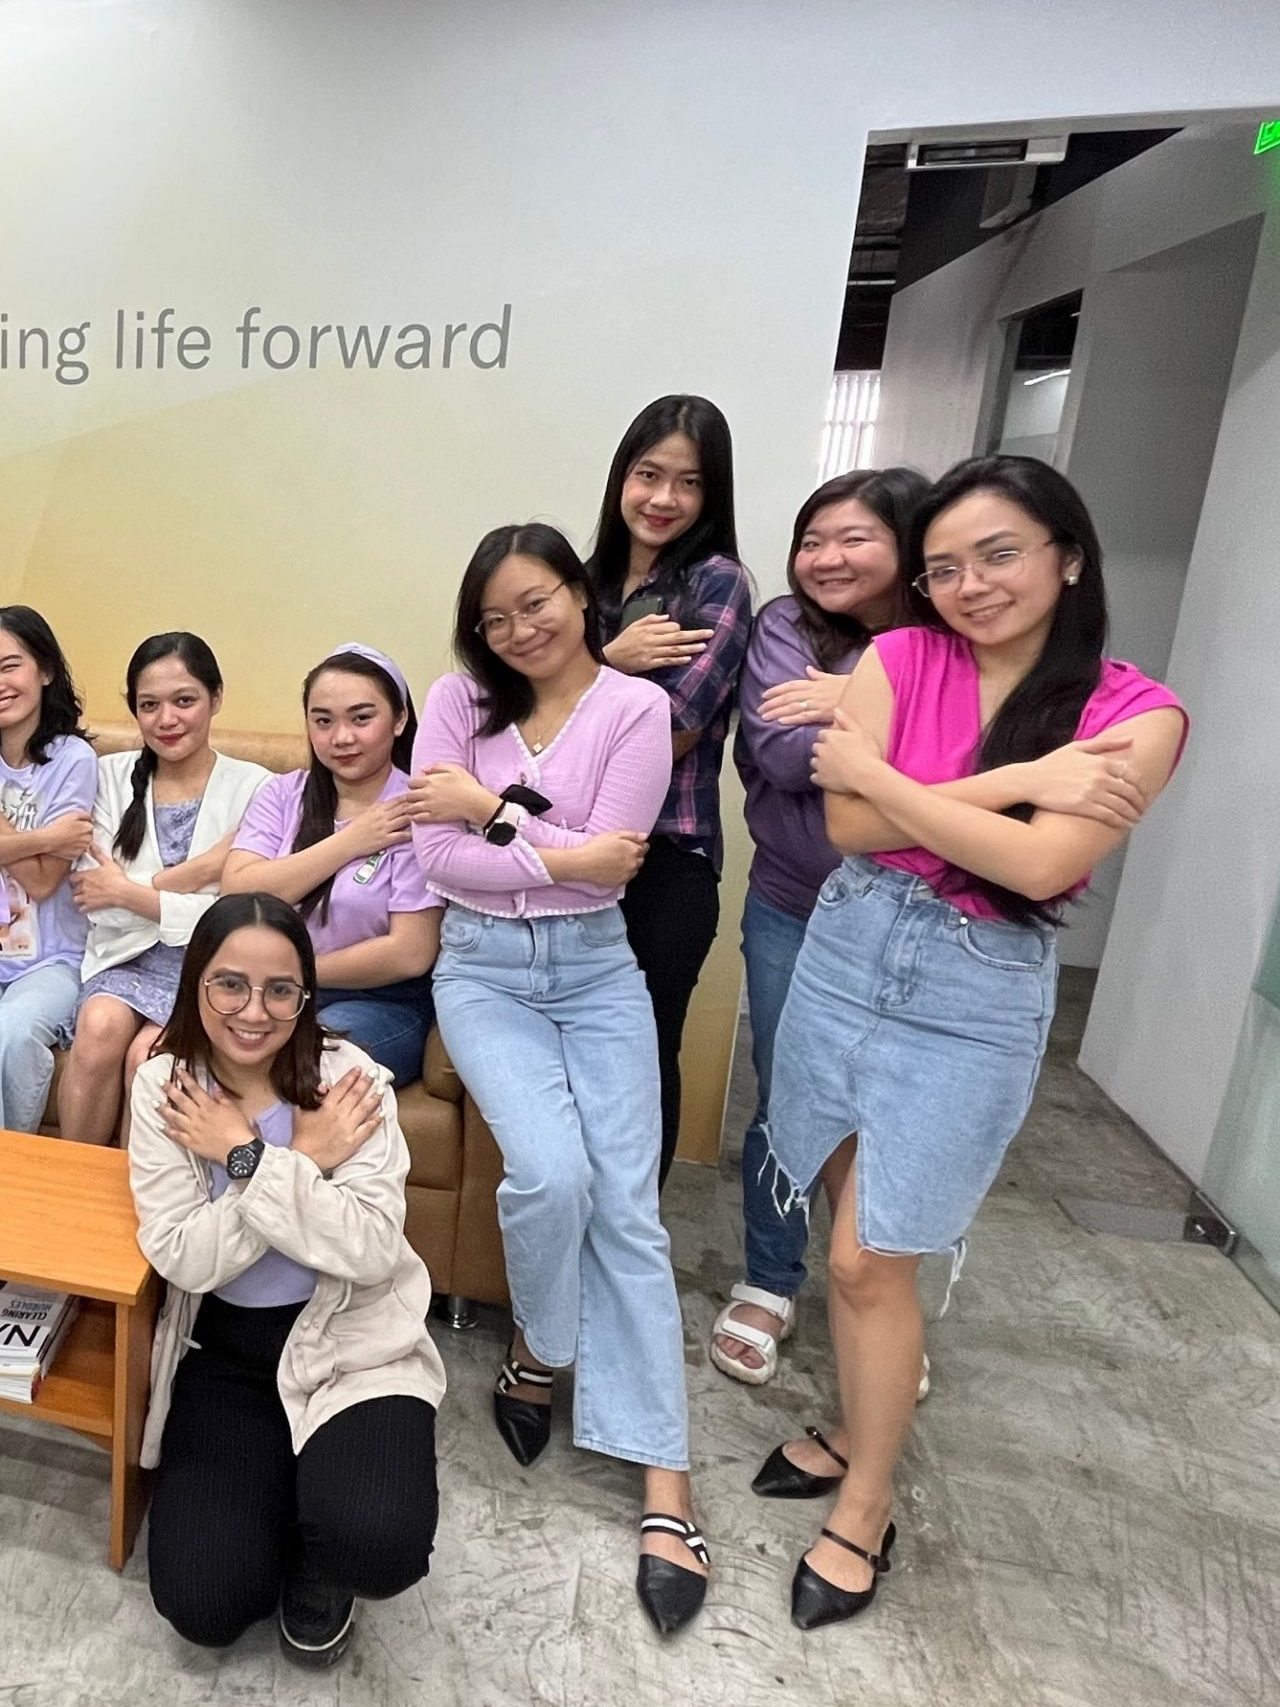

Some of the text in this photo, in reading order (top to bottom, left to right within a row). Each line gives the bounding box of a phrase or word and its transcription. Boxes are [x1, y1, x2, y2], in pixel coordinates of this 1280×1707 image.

[115, 307, 212, 370] life
[235, 303, 513, 370] forward
[8, 1299, 53, 1312] HURDLES
[0, 1307, 48, 1321] CLEARING
